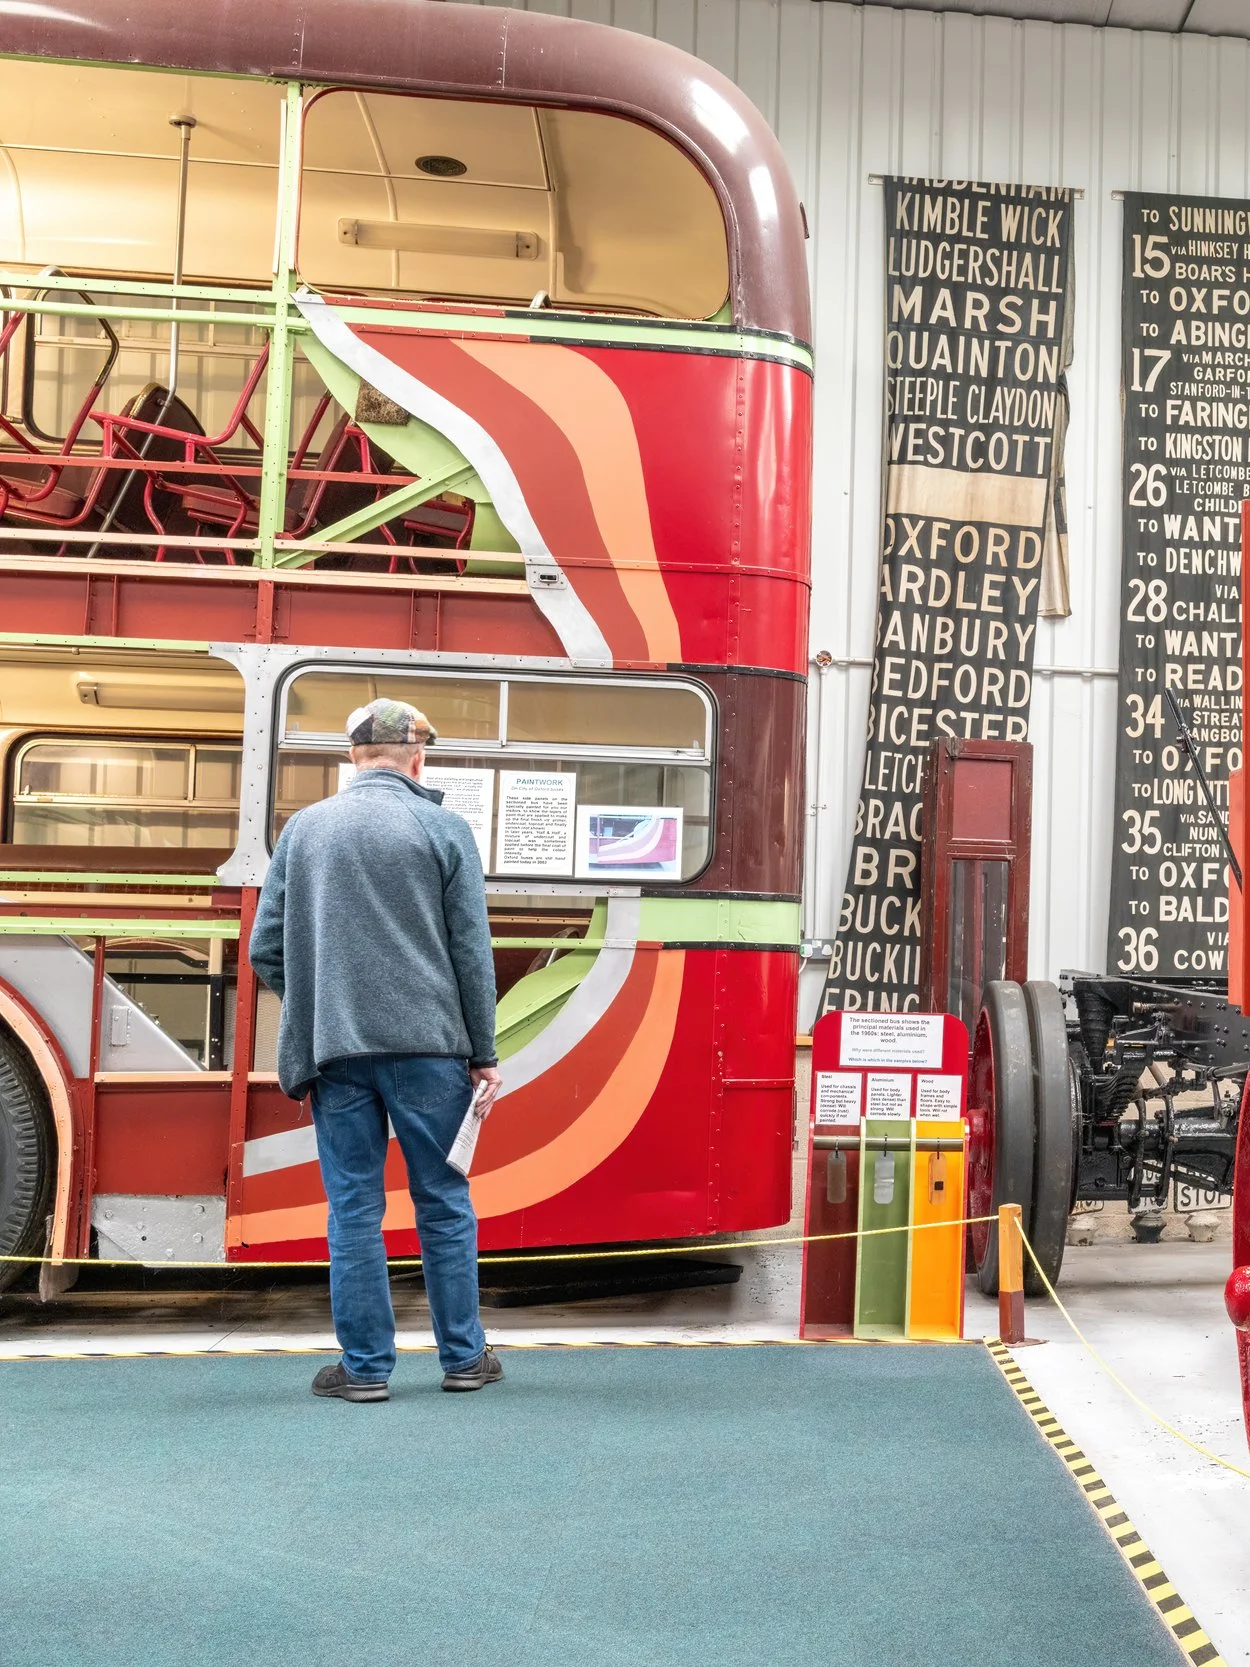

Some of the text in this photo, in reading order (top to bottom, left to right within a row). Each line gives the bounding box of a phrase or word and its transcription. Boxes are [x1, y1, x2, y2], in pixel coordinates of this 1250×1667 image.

[895, 191, 1064, 248] KIMBLE WICK
[1141, 209, 1160, 223] TO
[888, 236, 1063, 293] LUDGERSHALL
[1132, 234, 1171, 279] 15
[1171, 245, 1187, 255] VIA
[1188, 240, 1238, 260] HINKSEY
[1175, 262, 1236, 283] BOAR'S
[1140, 290, 1160, 304] TO
[892, 284, 1057, 339] MARSH
[1140, 323, 1159, 337] TO
[887, 331, 1059, 383] QUAINTON
[1131, 348, 1172, 393] 17
[1182, 353, 1200, 364] VIA
[966, 384, 1056, 429] CLAYDON
[1139, 404, 1158, 418] TO
[1138, 437, 1157, 451] TO
[1165, 433, 1242, 463] KINGSTON
[1128, 463, 1167, 508] 26
[1170, 467, 1187, 477] VIA
[1176, 480, 1234, 497] LETCOMBE
[1138, 514, 1242, 543] TO WANT
[1137, 552, 1157, 566] TO
[1127, 578, 1239, 623] 28 VIA
[1172, 601, 1242, 623] CHAL
[876, 610, 1035, 662] ANBURY
[1136, 630, 1242, 657] TO WANT
[1135, 663, 1243, 691] TO READ
[1125, 694, 1165, 738] 34
[1133, 750, 1153, 764] TO
[516, 778, 564, 786] PAINTWORK
[1132, 784, 1151, 797] TO
[1153, 778, 1194, 805] LONG
[1121, 809, 1162, 854] 35
[1180, 814, 1195, 824] VIA
[1190, 826, 1221, 840] NUN
[1163, 842, 1220, 858] CLIFTON
[1130, 866, 1149, 880] TO
[1129, 901, 1149, 915] TO
[1117, 927, 1159, 972] 36
[1173, 949, 1229, 971] COW
